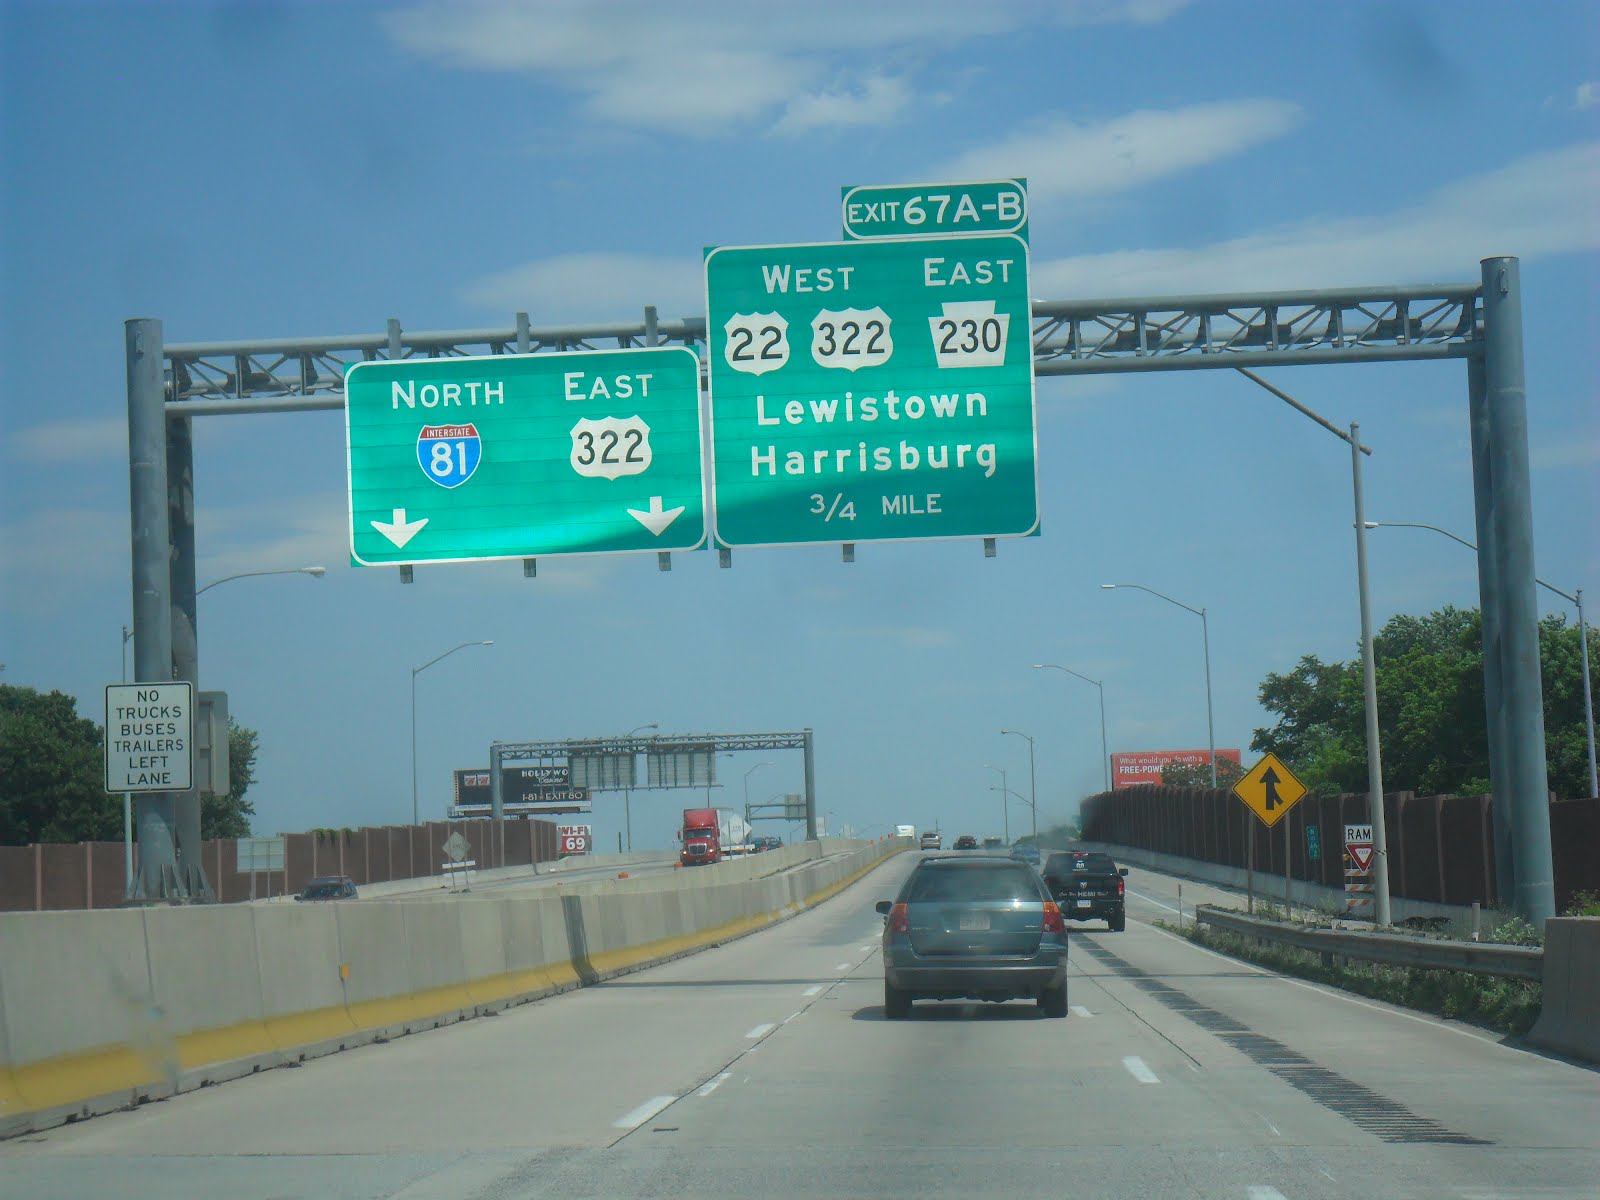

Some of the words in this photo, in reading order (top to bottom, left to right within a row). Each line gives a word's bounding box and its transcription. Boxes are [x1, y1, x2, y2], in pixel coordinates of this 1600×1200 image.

[848, 201, 900, 224] EXIT
[903, 191, 1022, 225] 67A-B
[761, 264, 855, 294] WEST
[923, 257, 1014, 287] EAST
[730, 325, 783, 362] 22
[817, 319, 885, 356] 322
[938, 318, 1001, 354] 230
[391, 380, 504, 409] NORTH
[564, 371, 653, 401] EAST
[756, 391, 987, 425] Lewistown
[426, 428, 471, 438] INTERSTATE
[576, 428, 644, 465] 322
[430, 441, 466, 477] 81
[751, 440, 996, 478] Harrisburg
[810, 493, 857, 522] 3/4
[882, 493, 942, 515] MILE
[137, 690, 159, 702] NO
[116, 705, 182, 719] TRUCKS
[121, 723, 176, 736] BUSES
[114, 739, 184, 753] TRAILERS
[129, 755, 169, 769] LEFT
[1120, 765, 1164, 774] FREE-POWE
[1159, 757, 1171, 765] you
[127, 772, 171, 785] LANE
[521, 769, 568, 778] HOLLYWO
[545, 792, 567, 801] EXIT
[566, 837, 585, 850] 69
[1347, 829, 1371, 840] RAM
